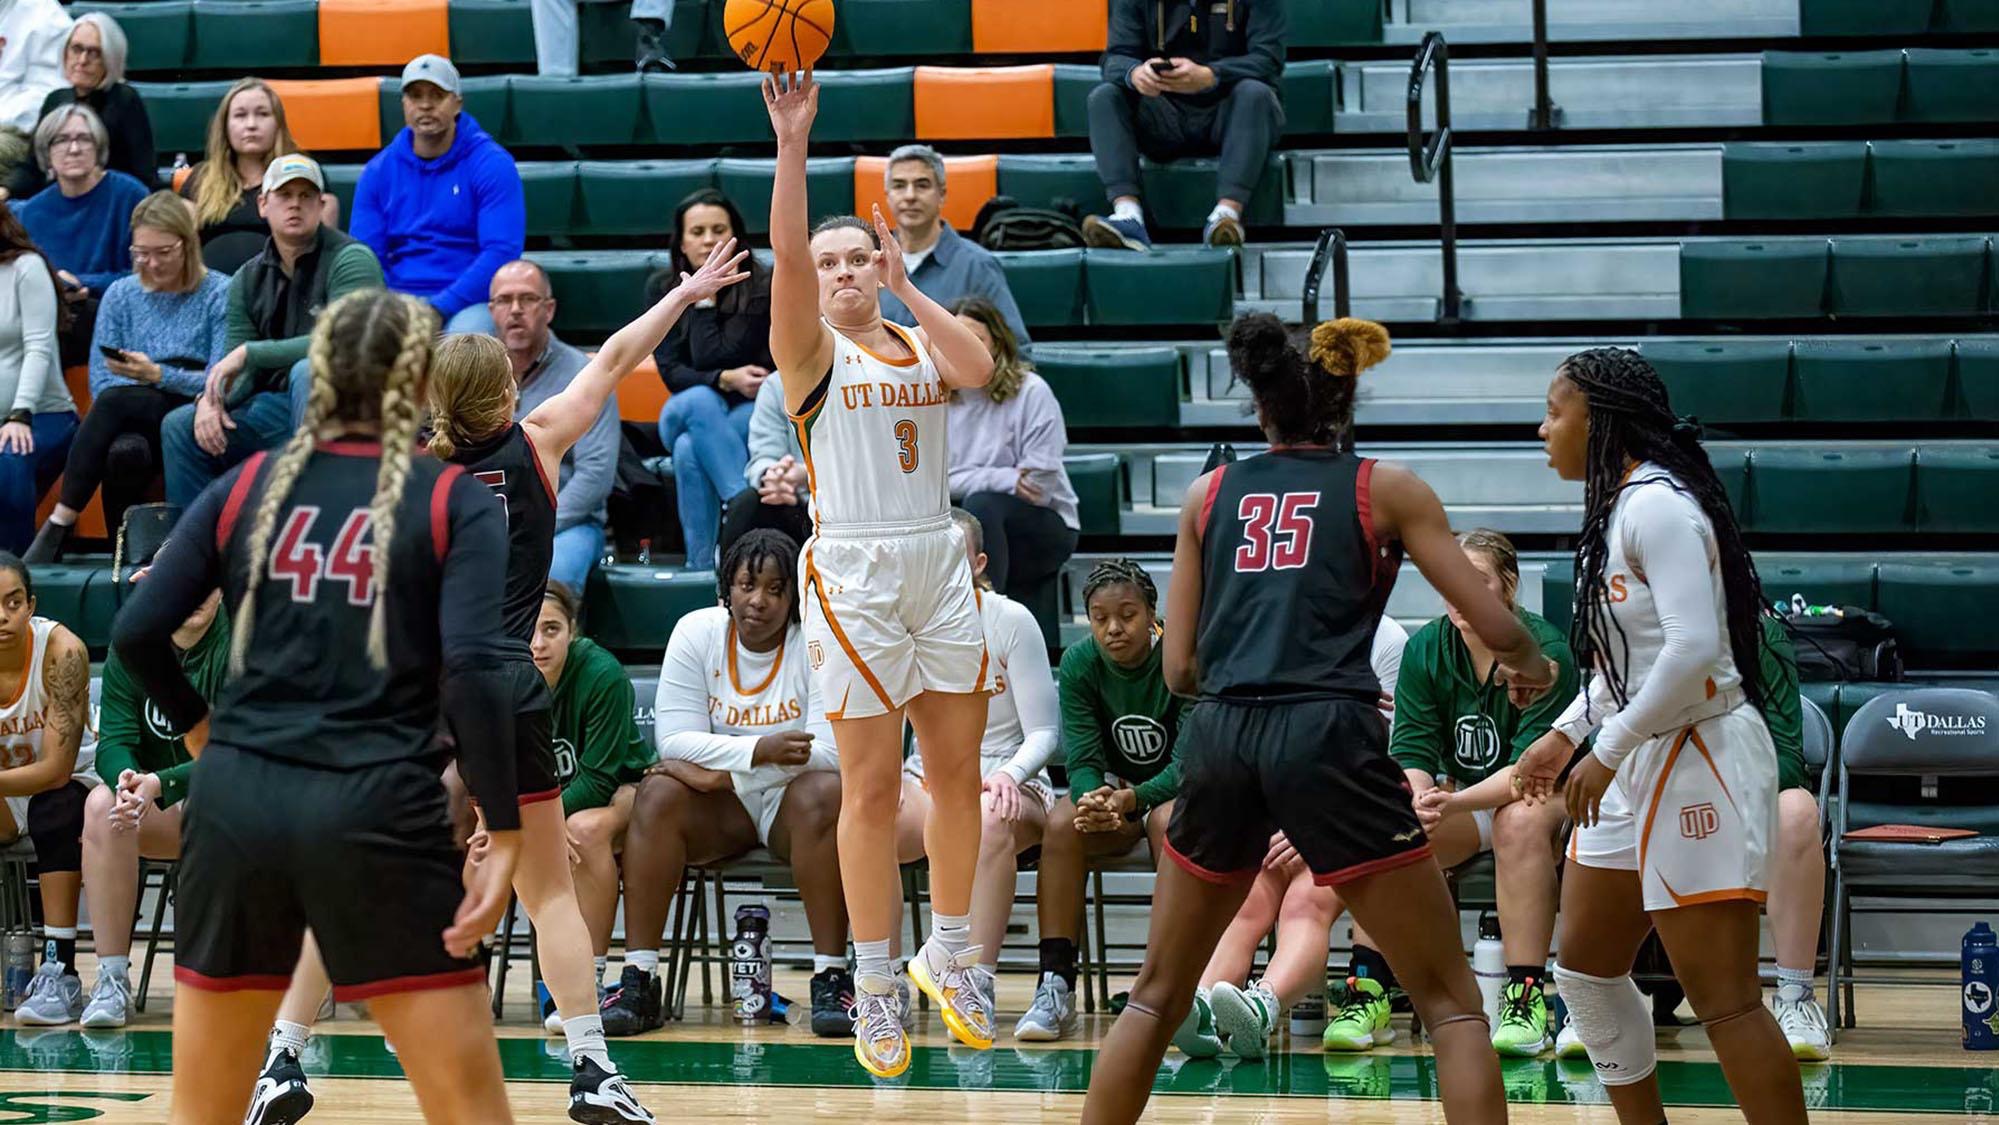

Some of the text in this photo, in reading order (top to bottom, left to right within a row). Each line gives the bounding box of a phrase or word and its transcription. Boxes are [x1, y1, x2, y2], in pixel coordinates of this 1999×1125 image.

[841, 382, 949, 411] UT DALLA
[894, 419, 919, 474] 3
[1235, 491, 1321, 573] 35
[268, 505, 378, 606] 44
[0, 705, 48, 736] ALLA
[726, 698, 801, 726] DALLAS
[1926, 714, 1986, 729] DALLAS
[1117, 723, 1163, 758] UTD
[1458, 722, 1495, 761] UTD
[1679, 802, 1720, 840] UTD
